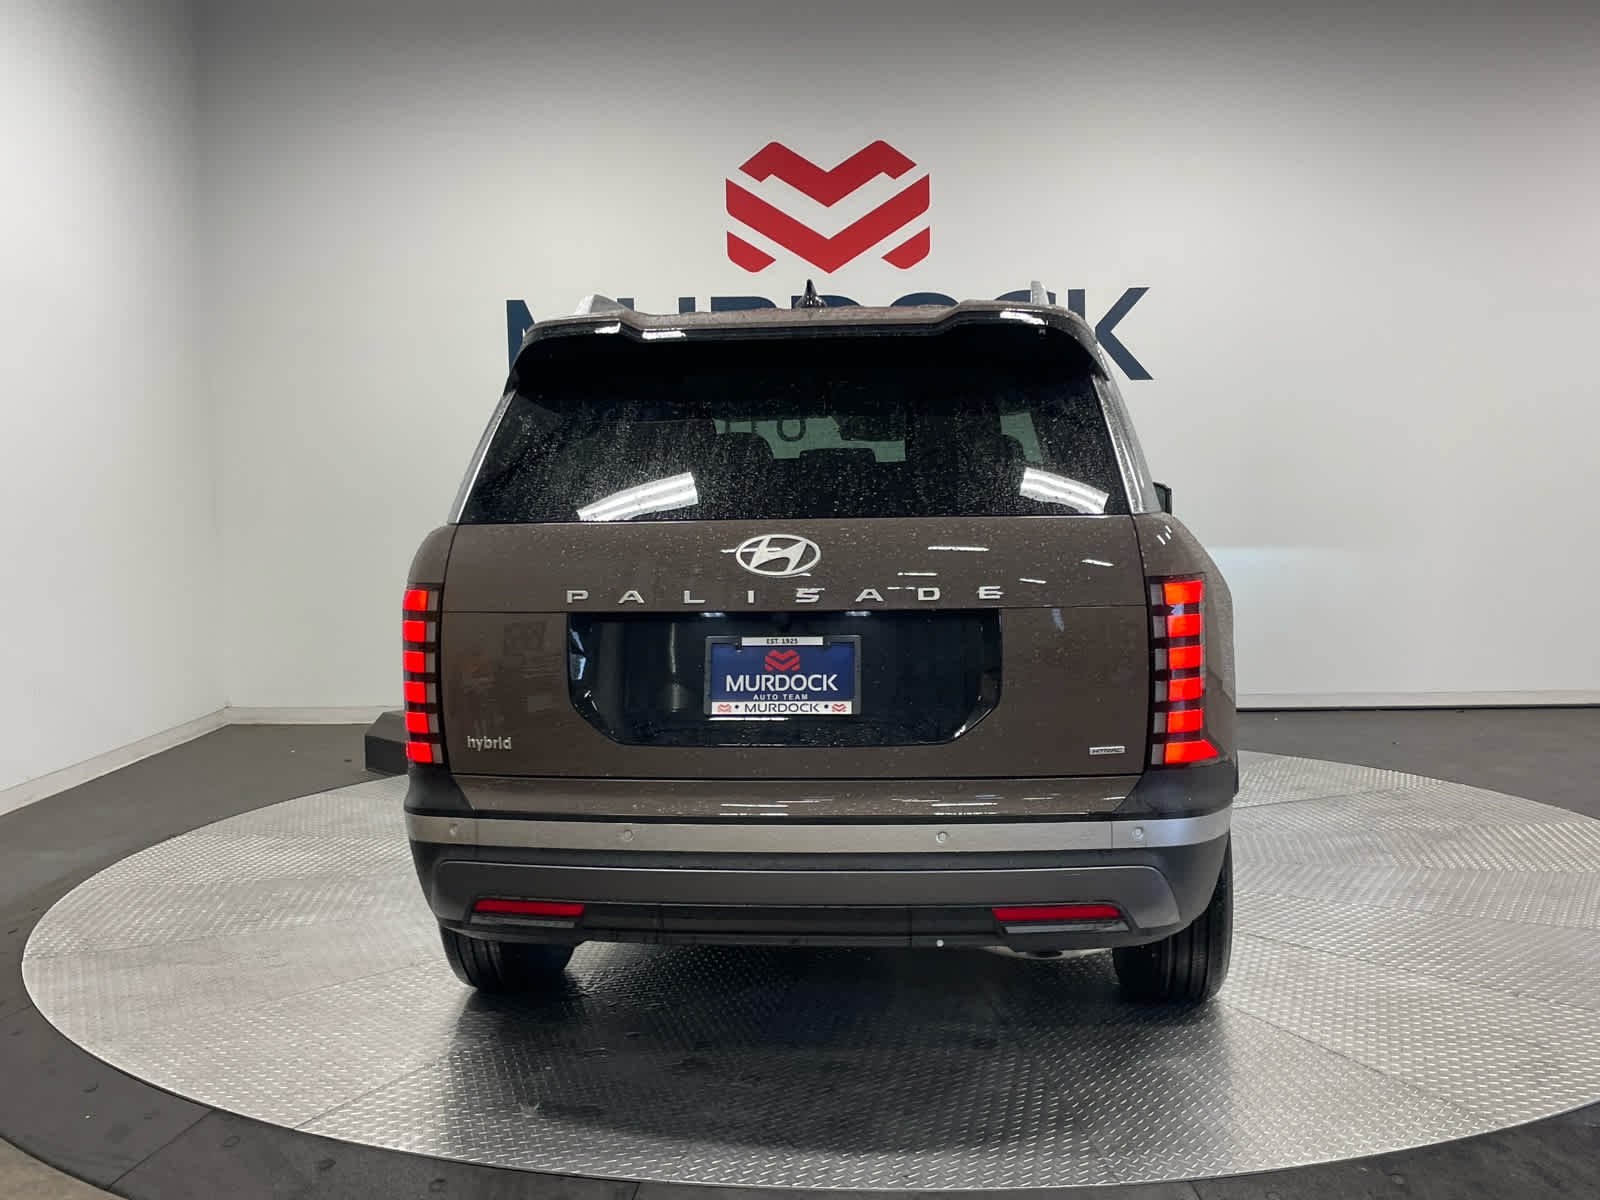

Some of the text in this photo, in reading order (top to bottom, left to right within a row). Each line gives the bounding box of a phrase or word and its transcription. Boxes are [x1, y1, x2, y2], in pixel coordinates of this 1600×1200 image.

[566, 585, 1002, 604] PALISADE
[725, 674, 838, 692] MURDOCK
[744, 703, 820, 713] MURDOCK
[467, 735, 512, 752] hybrid
